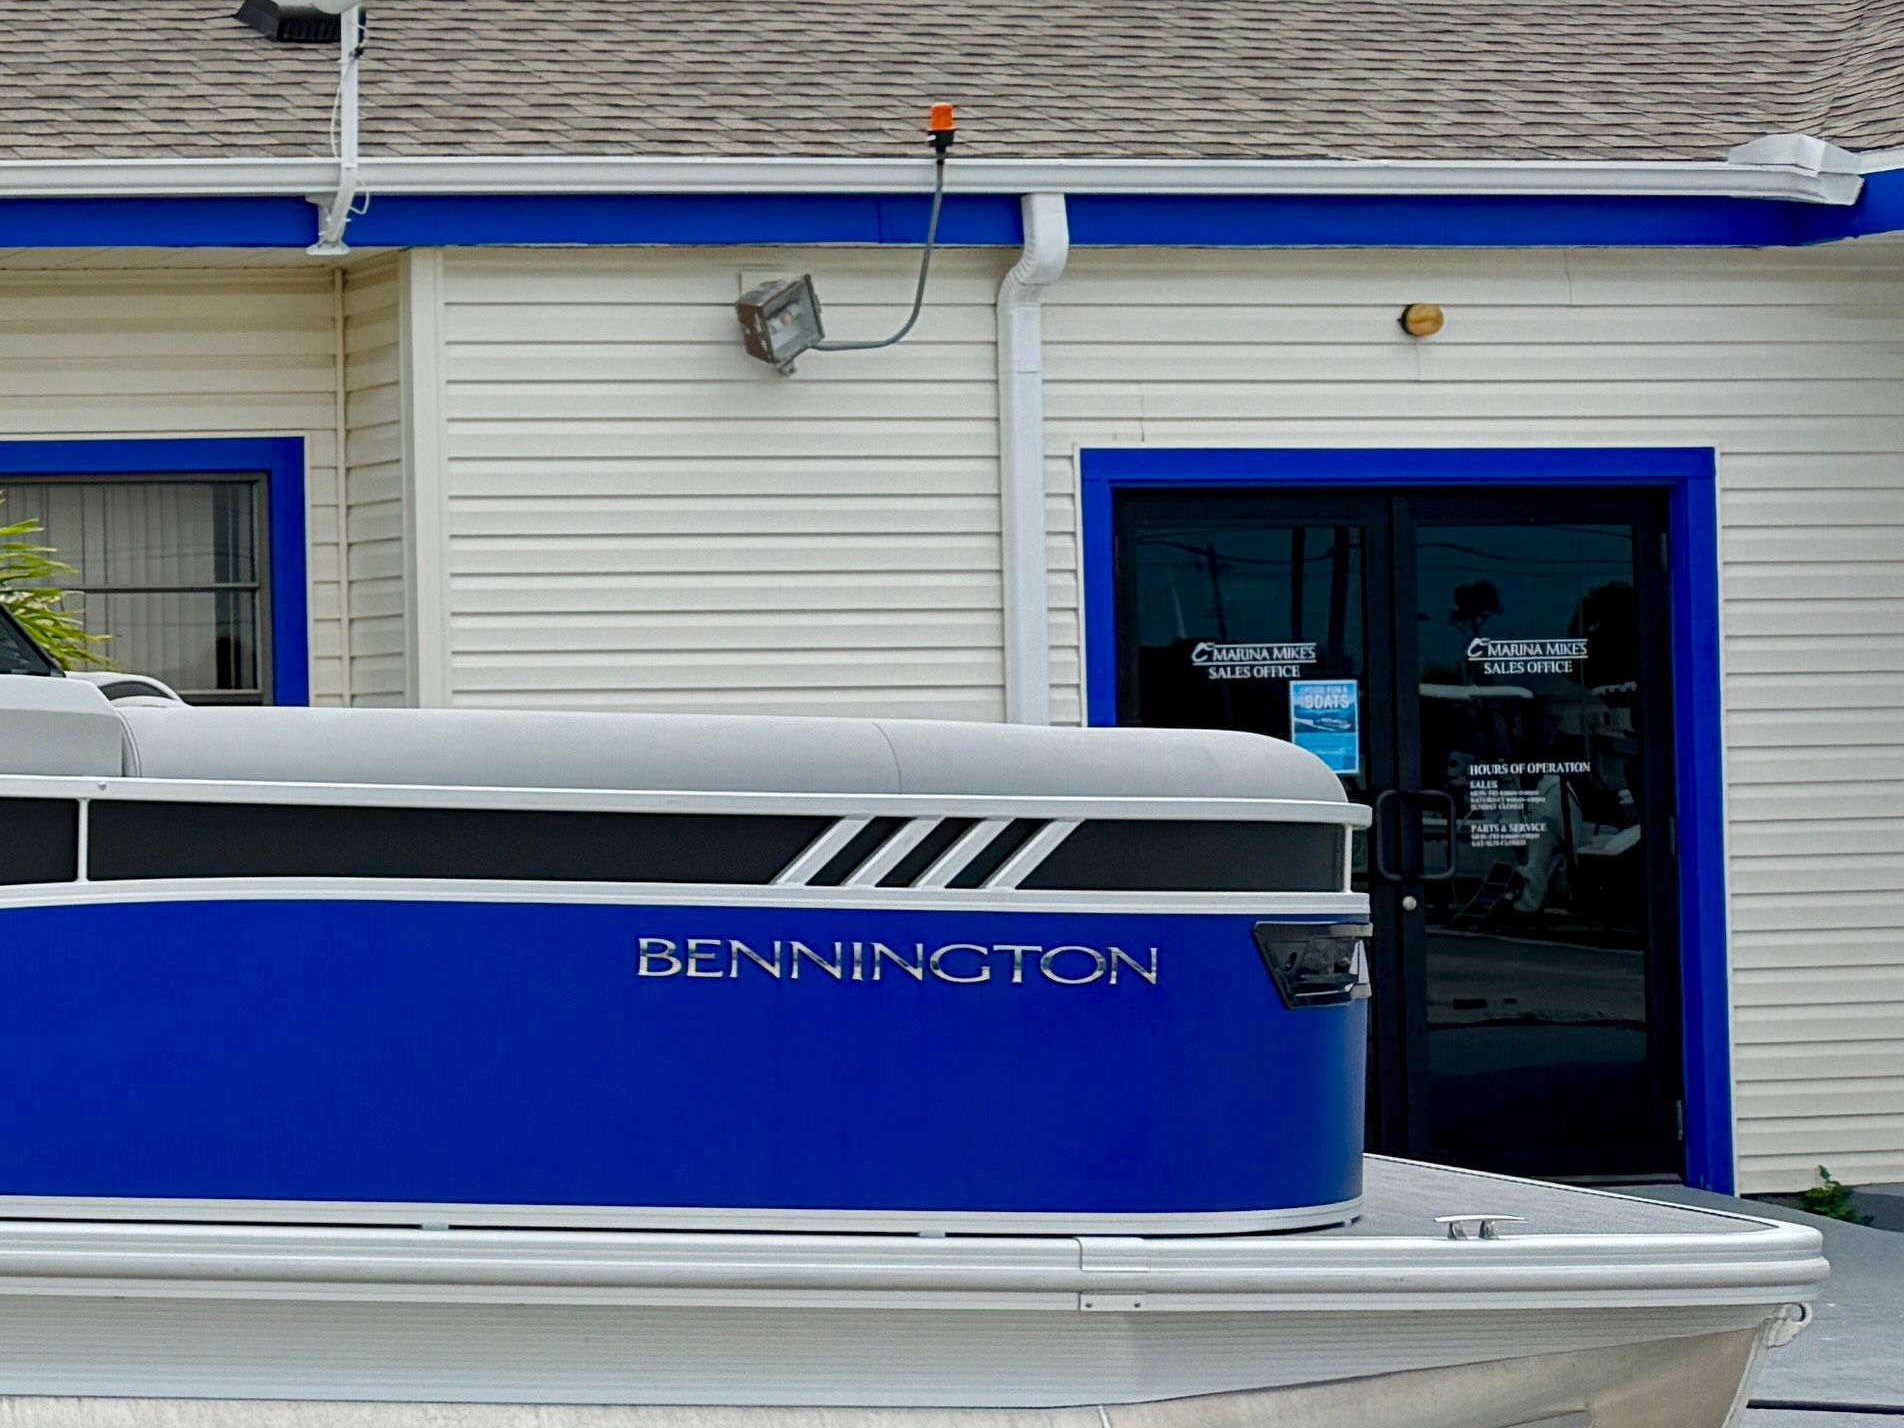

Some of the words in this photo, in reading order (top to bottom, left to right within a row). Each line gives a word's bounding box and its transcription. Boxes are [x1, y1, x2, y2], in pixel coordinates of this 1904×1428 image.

[1212, 646, 1270, 661] MARINA
[1487, 643, 1542, 657] MARINA
[1208, 666, 1251, 679] SALES
[1253, 665, 1301, 678] OFFICE
[1483, 661, 1525, 675] SALES
[1527, 660, 1573, 674] OFFICE
[1304, 694, 1349, 709] BOATS
[1469, 763, 1509, 775] HOURS
[1510, 762, 1525, 774] OF
[1527, 761, 1591, 774] OPERATION
[637, 937, 1158, 986] BENNINGTON
